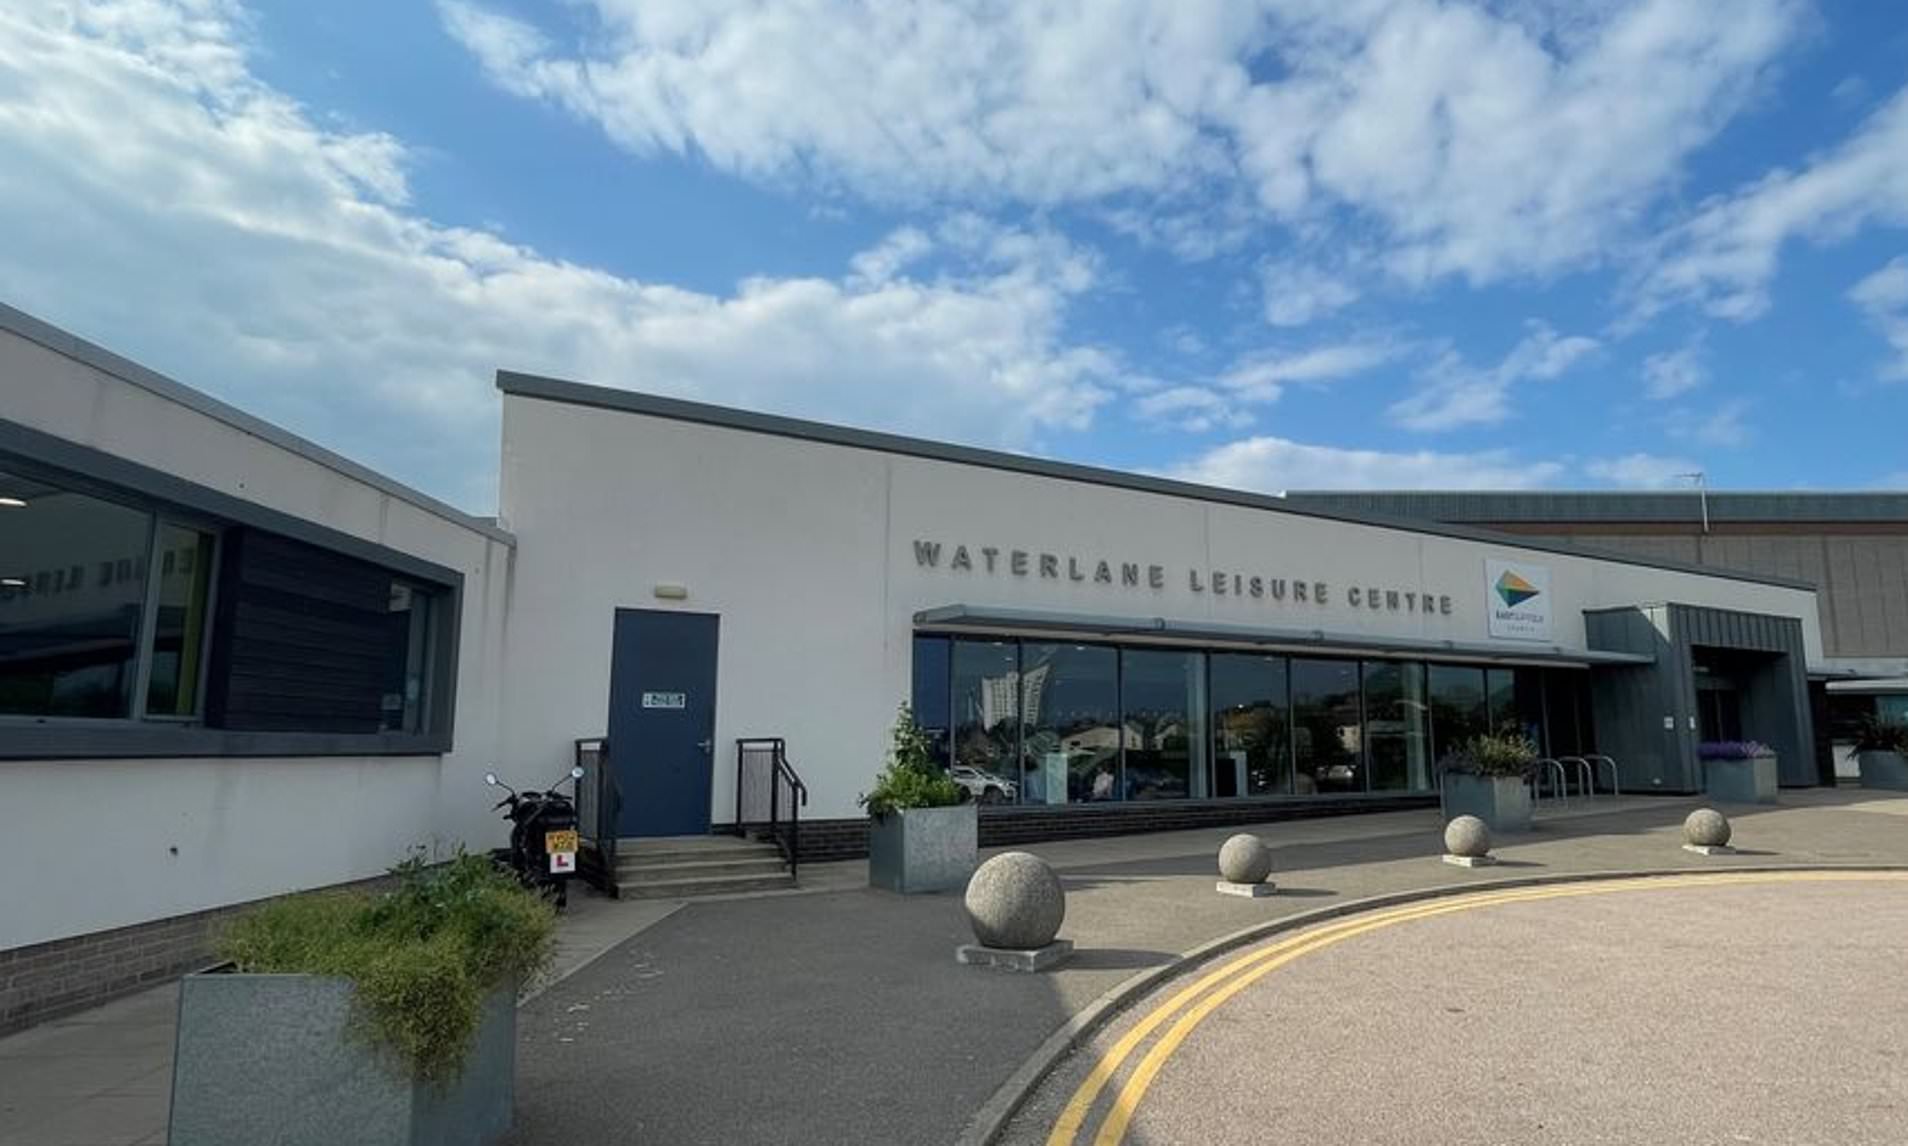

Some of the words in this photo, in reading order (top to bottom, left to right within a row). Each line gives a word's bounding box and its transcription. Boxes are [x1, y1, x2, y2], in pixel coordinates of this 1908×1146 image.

[913, 539, 1165, 589] WATERLANE
[1189, 569, 1329, 605] LEISURE
[1347, 586, 1453, 615] CENTRE
[557, 855, 569, 866] L
